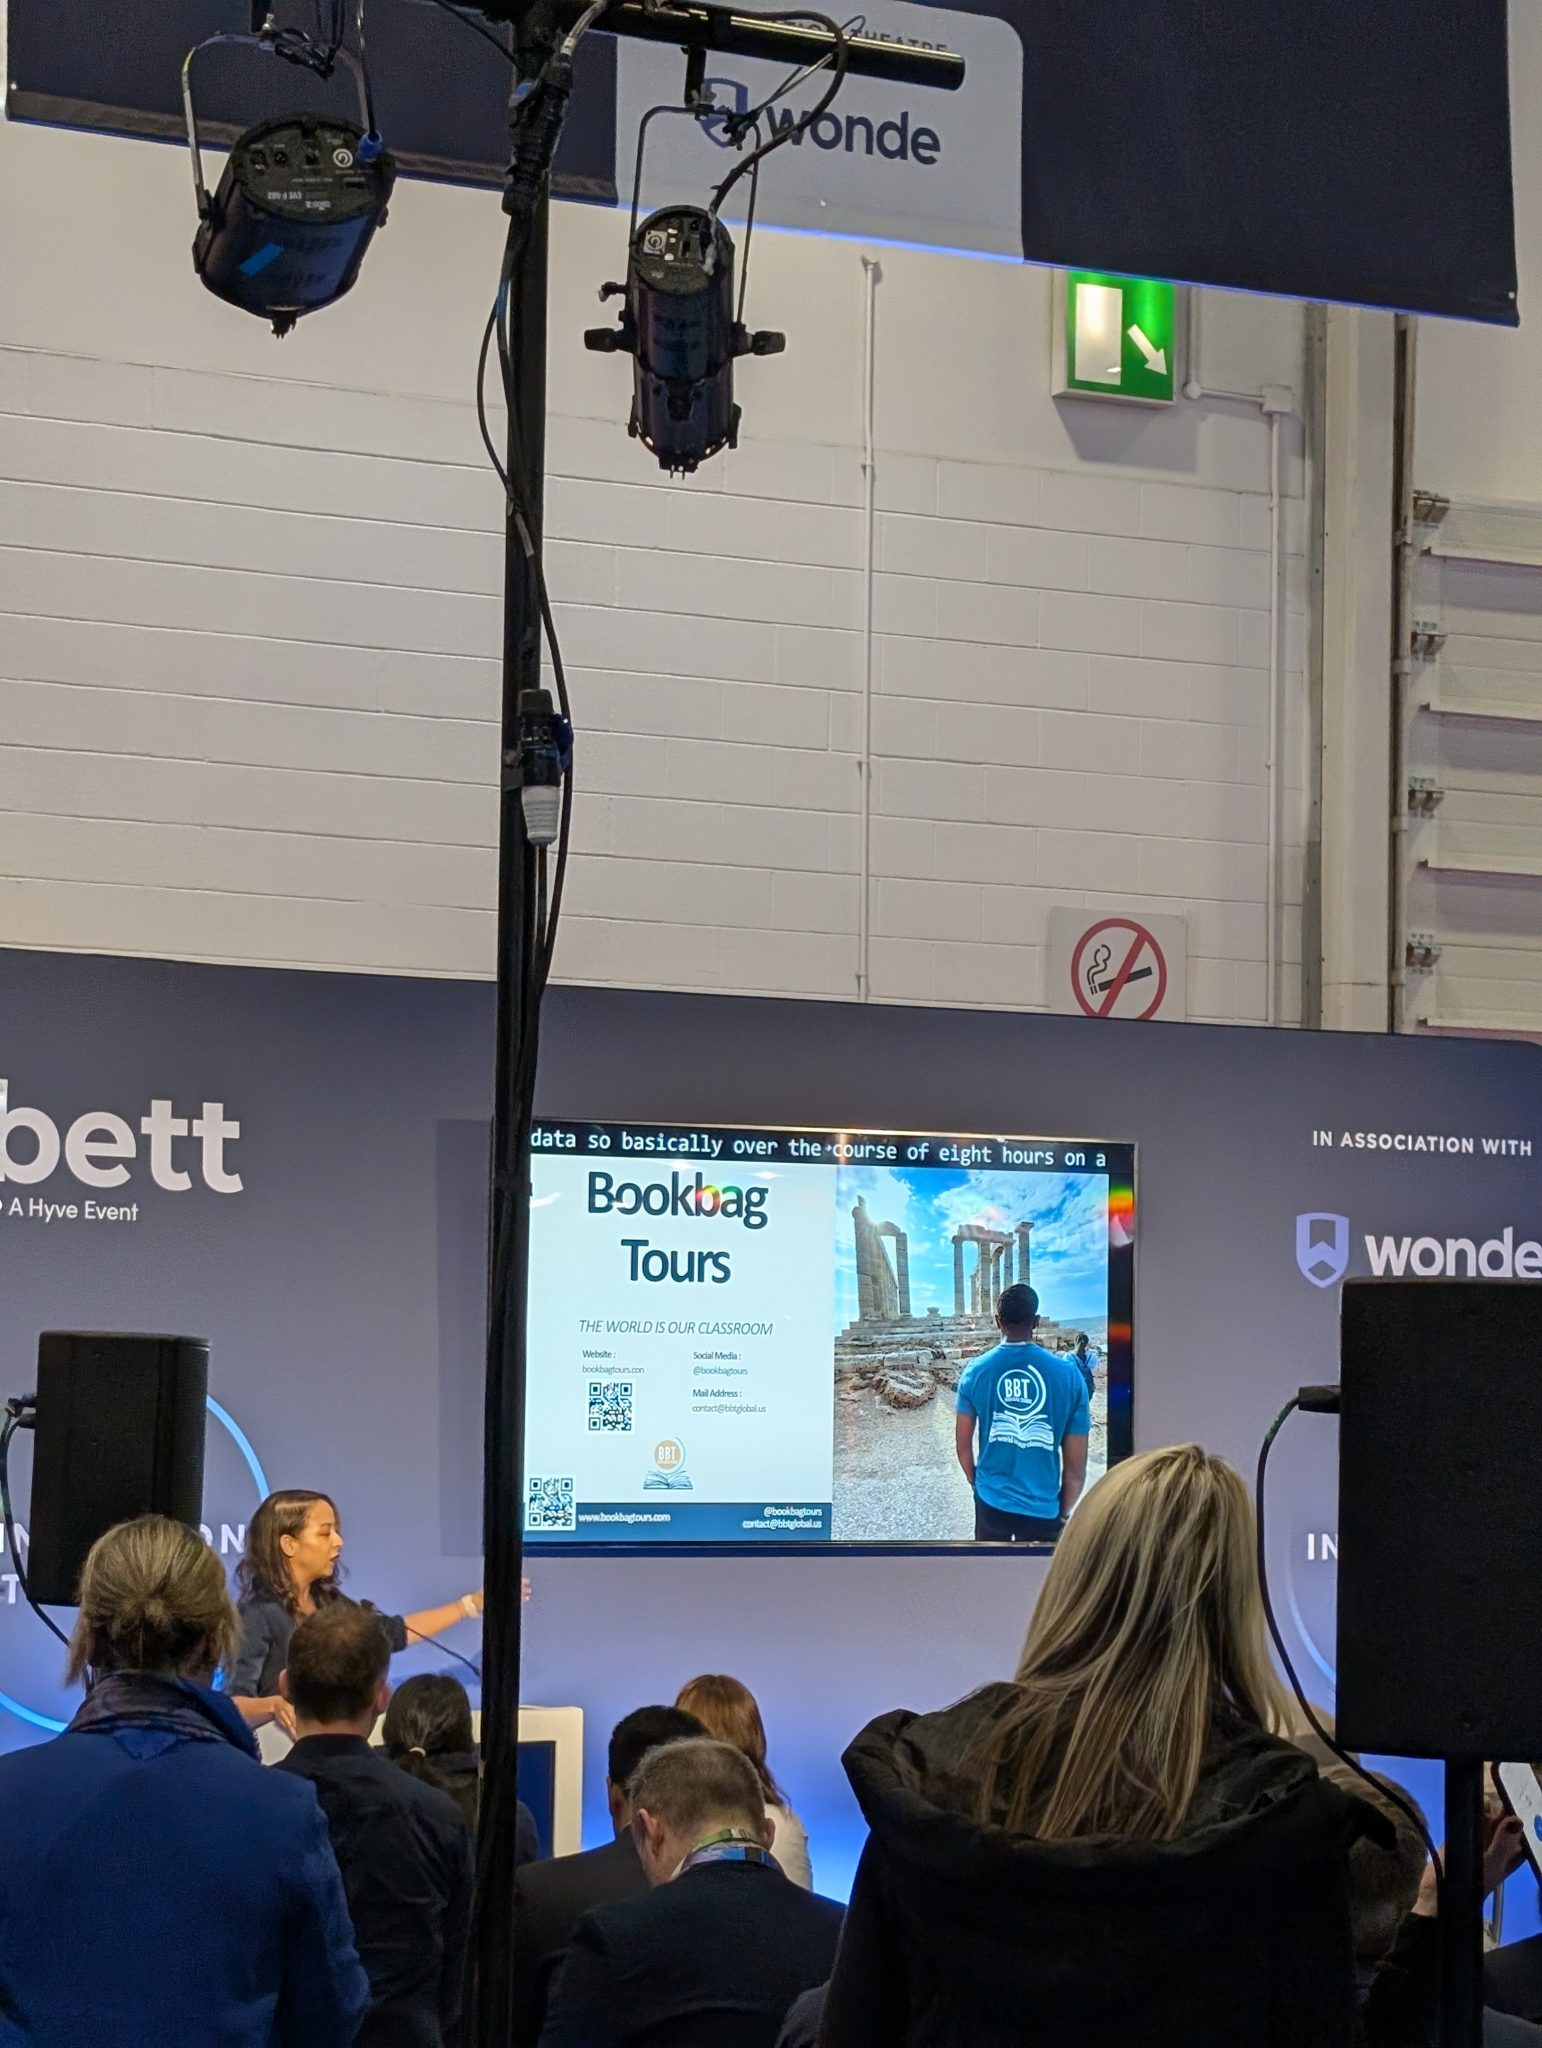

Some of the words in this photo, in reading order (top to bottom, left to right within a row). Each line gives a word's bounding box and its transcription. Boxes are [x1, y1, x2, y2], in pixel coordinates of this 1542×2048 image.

[767, 106, 941, 166] wonde
[0, 1078, 244, 1193] bett
[1313, 1130, 1333, 1147] IN
[1340, 1131, 1474, 1154] ASSOCIATION
[1481, 1138, 1532, 1157] WITH
[530, 1128, 577, 1148] data
[588, 1134, 611, 1149] so
[622, 1131, 723, 1157] basically
[733, 1140, 779, 1155] over
[788, 1139, 822, 1156] the
[833, 1143, 898, 1160] course
[907, 1142, 930, 1161] of
[939, 1144, 992, 1167] eight
[1002, 1146, 1054, 1165] hours
[1065, 1152, 1086, 1167] on
[1096, 1153, 1107, 1167] a
[587, 1171, 769, 1230] Bookbag
[8, 1199, 24, 1216] A
[29, 1198, 79, 1224] Hyve
[85, 1200, 139, 1222] Event
[621, 1239, 731, 1284] Tours
[1365, 1227, 1542, 1278] wonde
[579, 1319, 604, 1334] THE
[605, 1320, 653, 1335] WORLD
[655, 1321, 666, 1334] IS
[667, 1321, 695, 1335] OUR
[697, 1322, 774, 1336] CLASSROOM
[582, 1350, 612, 1359] Website
[693, 1351, 714, 1360] Social
[715, 1351, 738, 1360] Media
[693, 1366, 748, 1377] @bookbagtours
[692, 1389, 708, 1398] Mail
[709, 1389, 738, 1398] Address
[1004, 1378, 1030, 1398] BBT
[692, 1404, 767, 1414] contact@bbtglobal.us
[658, 1446, 677, 1460] BBT
[578, 1512, 671, 1524] www.bookbagtours.com
